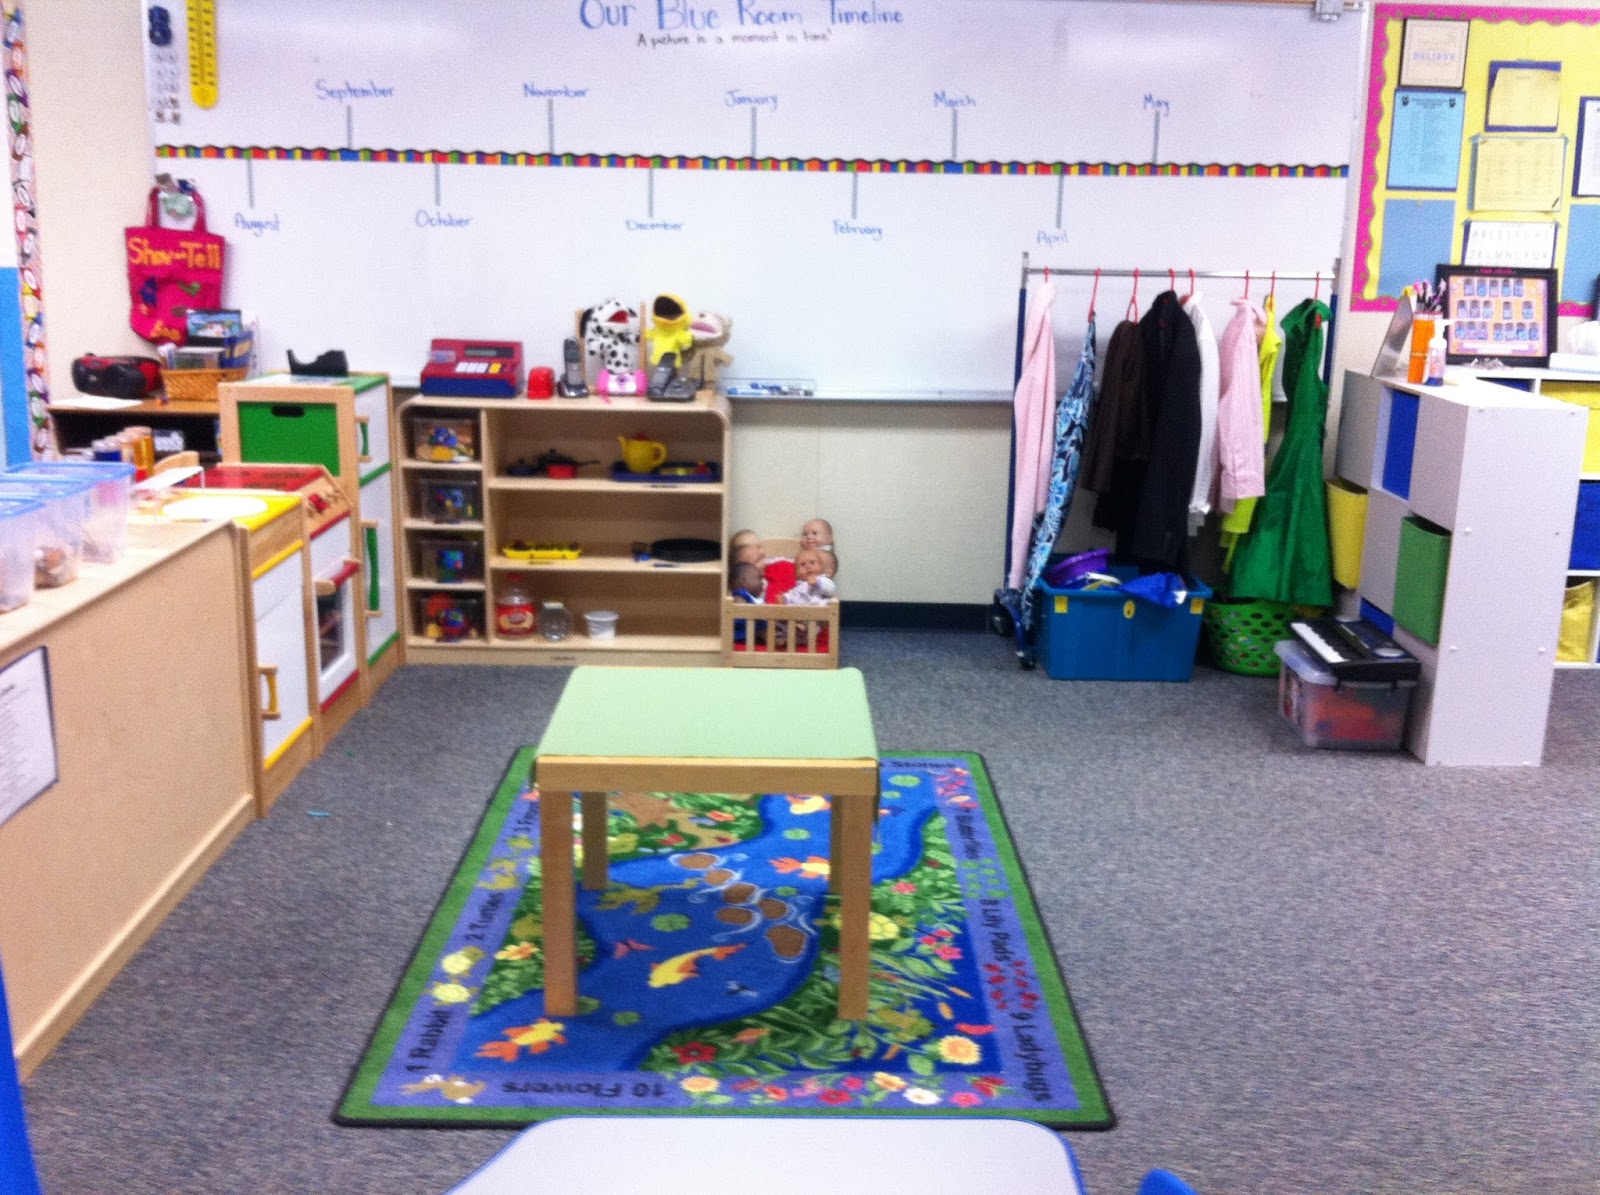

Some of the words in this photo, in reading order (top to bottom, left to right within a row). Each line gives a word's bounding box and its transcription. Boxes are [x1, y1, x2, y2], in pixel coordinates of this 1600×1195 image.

[580, 0, 636, 29] Our
[657, 0, 721, 30] Blue
[738, 0, 803, 26] Room
[831, 0, 903, 24] Timeline
[650, 33, 689, 48] picture
[697, 34, 707, 44] is
[715, 35, 724, 44] a
[731, 30, 778, 43] moment
[786, 34, 798, 43] in
[315, 79, 394, 102] September
[524, 82, 588, 98] November
[934, 91, 976, 107] March
[725, 90, 778, 111] January
[1144, 94, 1169, 117] May
[234, 212, 280, 237] August
[415, 209, 473, 227] October
[625, 219, 684, 231] December
[832, 219, 883, 241] February
[1037, 230, 1068, 248] April
[981, 908, 1004, 928] Lily
[989, 931, 1014, 962] Pads
[407, 1010, 452, 1059] Rabbit
[1013, 1024, 1053, 1102] Ladybugs
[502, 1082, 622, 1098] Flowers
[632, 1082, 666, 1098] 10
